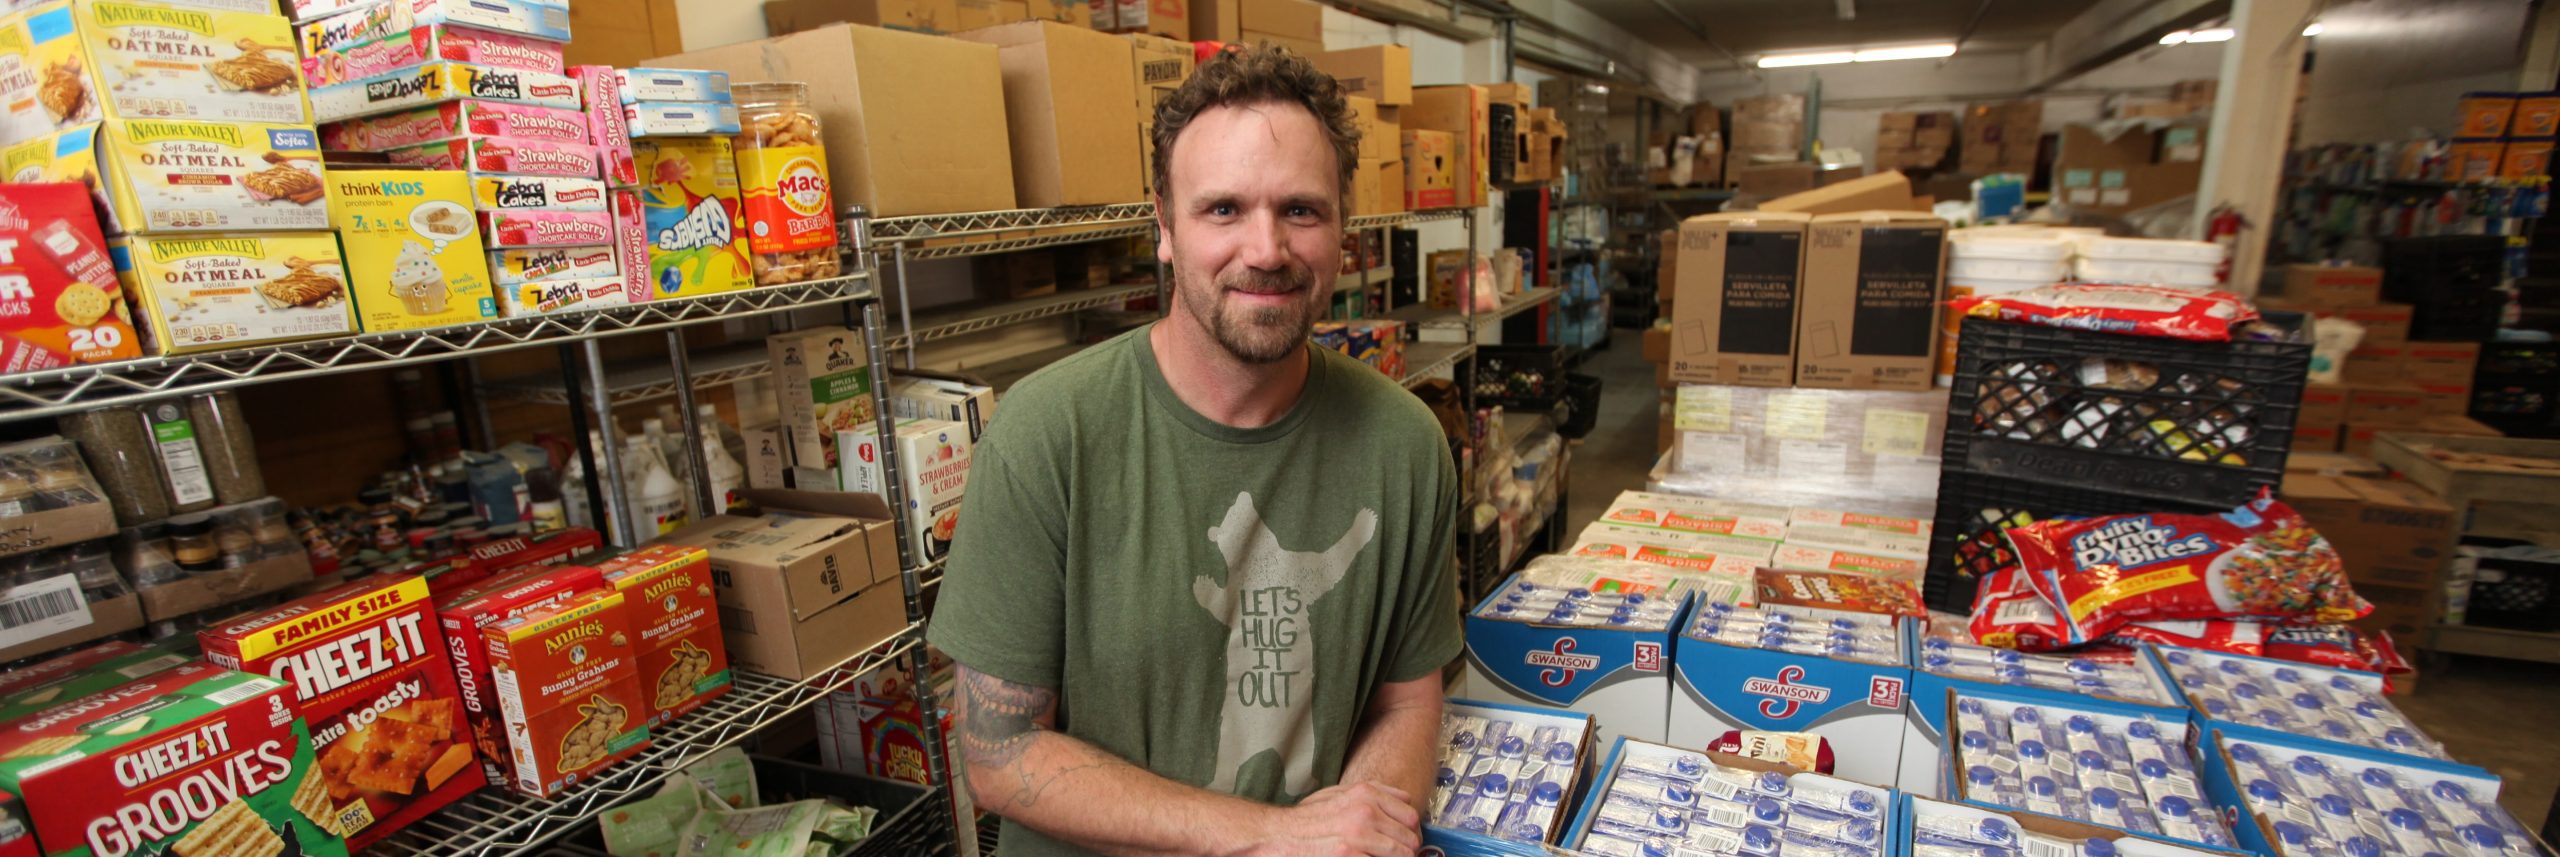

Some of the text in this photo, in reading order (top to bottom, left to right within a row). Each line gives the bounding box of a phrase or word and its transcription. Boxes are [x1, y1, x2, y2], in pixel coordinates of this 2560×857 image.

[100, 6, 208, 33] NATURE VALLEY
[107, 37, 216, 57] OATMEAL
[310, 23, 348, 53] Zebra
[481, 41, 557, 71] Strawberry
[482, 56, 548, 71] SHORTCAKE ROLLS
[465, 68, 518, 85] Zebra
[1144, 61, 1181, 83] PAYDAY
[400, 71, 440, 98] Zebra
[472, 84, 518, 99] Cakes
[532, 86, 571, 96] Little Debbie
[598, 73, 620, 146] Strawberry
[131, 123, 240, 144] NATURE VALLEY
[510, 113, 583, 139] Strawberry
[511, 128, 574, 139] SHORTCAKE ROLLS
[161, 143, 219, 154] Soft-Baked
[274, 133, 309, 147] Softer
[141, 153, 245, 167] OATMEAL
[518, 148, 592, 173] Strawberry
[519, 163, 583, 174] SHORTCAKE ROLLS
[491, 179, 544, 195] Zebra
[559, 190, 597, 201] Little Debbie
[777, 175, 827, 198] Mac's
[345, 200, 374, 208] protein
[499, 194, 545, 207] Cakes
[537, 219, 607, 240] Strawberry
[659, 195, 731, 250] Gushers
[538, 233, 599, 242] SHORTCAKE ROLLS
[702, 236, 723, 248] FRUIT
[155, 239, 259, 260] NATURE VALLEY
[67, 250, 100, 273] PEANUT
[185, 258, 241, 269] Soft-Baked
[516, 250, 566, 270] Zebra
[576, 254, 609, 266] Little Debbie
[630, 228, 646, 297] Strawberry
[78, 261, 112, 283] BUTTER
[165, 268, 266, 284] OATMEAL
[453, 281, 483, 294] cupcake
[531, 282, 579, 304] Zebra
[589, 285, 621, 298] Little Debbie
[1727, 290, 1791, 299] PARA COMIDA
[1732, 282, 1787, 290] SERVILLETA
[1861, 290, 1931, 299] PARA COMIDA
[1867, 281, 1927, 289] SERVILLETA
[484, 299, 490, 308] 5
[68, 326, 122, 351] 20
[175, 328, 188, 336] 230
[83, 350, 113, 359] PACKS
[826, 358, 853, 371] QUAKER
[1675, 361, 1687, 370] 20
[1803, 364, 1817, 374] 20
[830, 379, 851, 388] APPLES
[830, 383, 859, 395] CINNAMON
[920, 458, 971, 486] STRAWBERRIES
[2018, 451, 2186, 490] Dean Foods
[932, 474, 963, 494] & CREAM
[2119, 537, 2208, 566] Bites
[636, 558, 690, 584] GLUTEN FREE
[825, 554, 842, 594] DAVID
[644, 572, 692, 603] Annie's
[1240, 586, 1302, 616] LET'S
[273, 590, 402, 647] FAMILY SIZE
[475, 614, 499, 629] EXTRA
[534, 613, 574, 632] GLUTEN
[577, 604, 602, 616] FREE
[642, 623, 669, 640] Bunny
[670, 608, 705, 627] Grahams
[654, 613, 676, 625] GLUTEN
[545, 619, 604, 656] Annie's
[1241, 617, 1298, 649] HUG
[1252, 647, 1292, 671] IT
[1532, 654, 1591, 668] SWANSON
[1637, 646, 1650, 662] 3
[449, 635, 482, 713] GROOVES
[541, 677, 575, 696] Bunny
[577, 658, 620, 681] Grahams
[557, 657, 602, 679] GLUTEN FREE
[321, 667, 405, 703] baked snack crackers
[563, 675, 604, 696] SnickerDoodle
[1238, 671, 1300, 708] OUT
[1750, 681, 1820, 700] SWANSON
[1874, 680, 1899, 700] 3 PACK
[19, 682, 158, 732] GROOVES
[269, 695, 283, 712] 3
[269, 709, 291, 722] BOXES
[270, 714, 293, 728] INSIDE
[311, 679, 420, 750] extra toasty
[888, 742, 922, 767] Lucky
[886, 760, 928, 785] Charms
[86, 740, 292, 857] GROOVES
[344, 814, 366, 829] REAL
